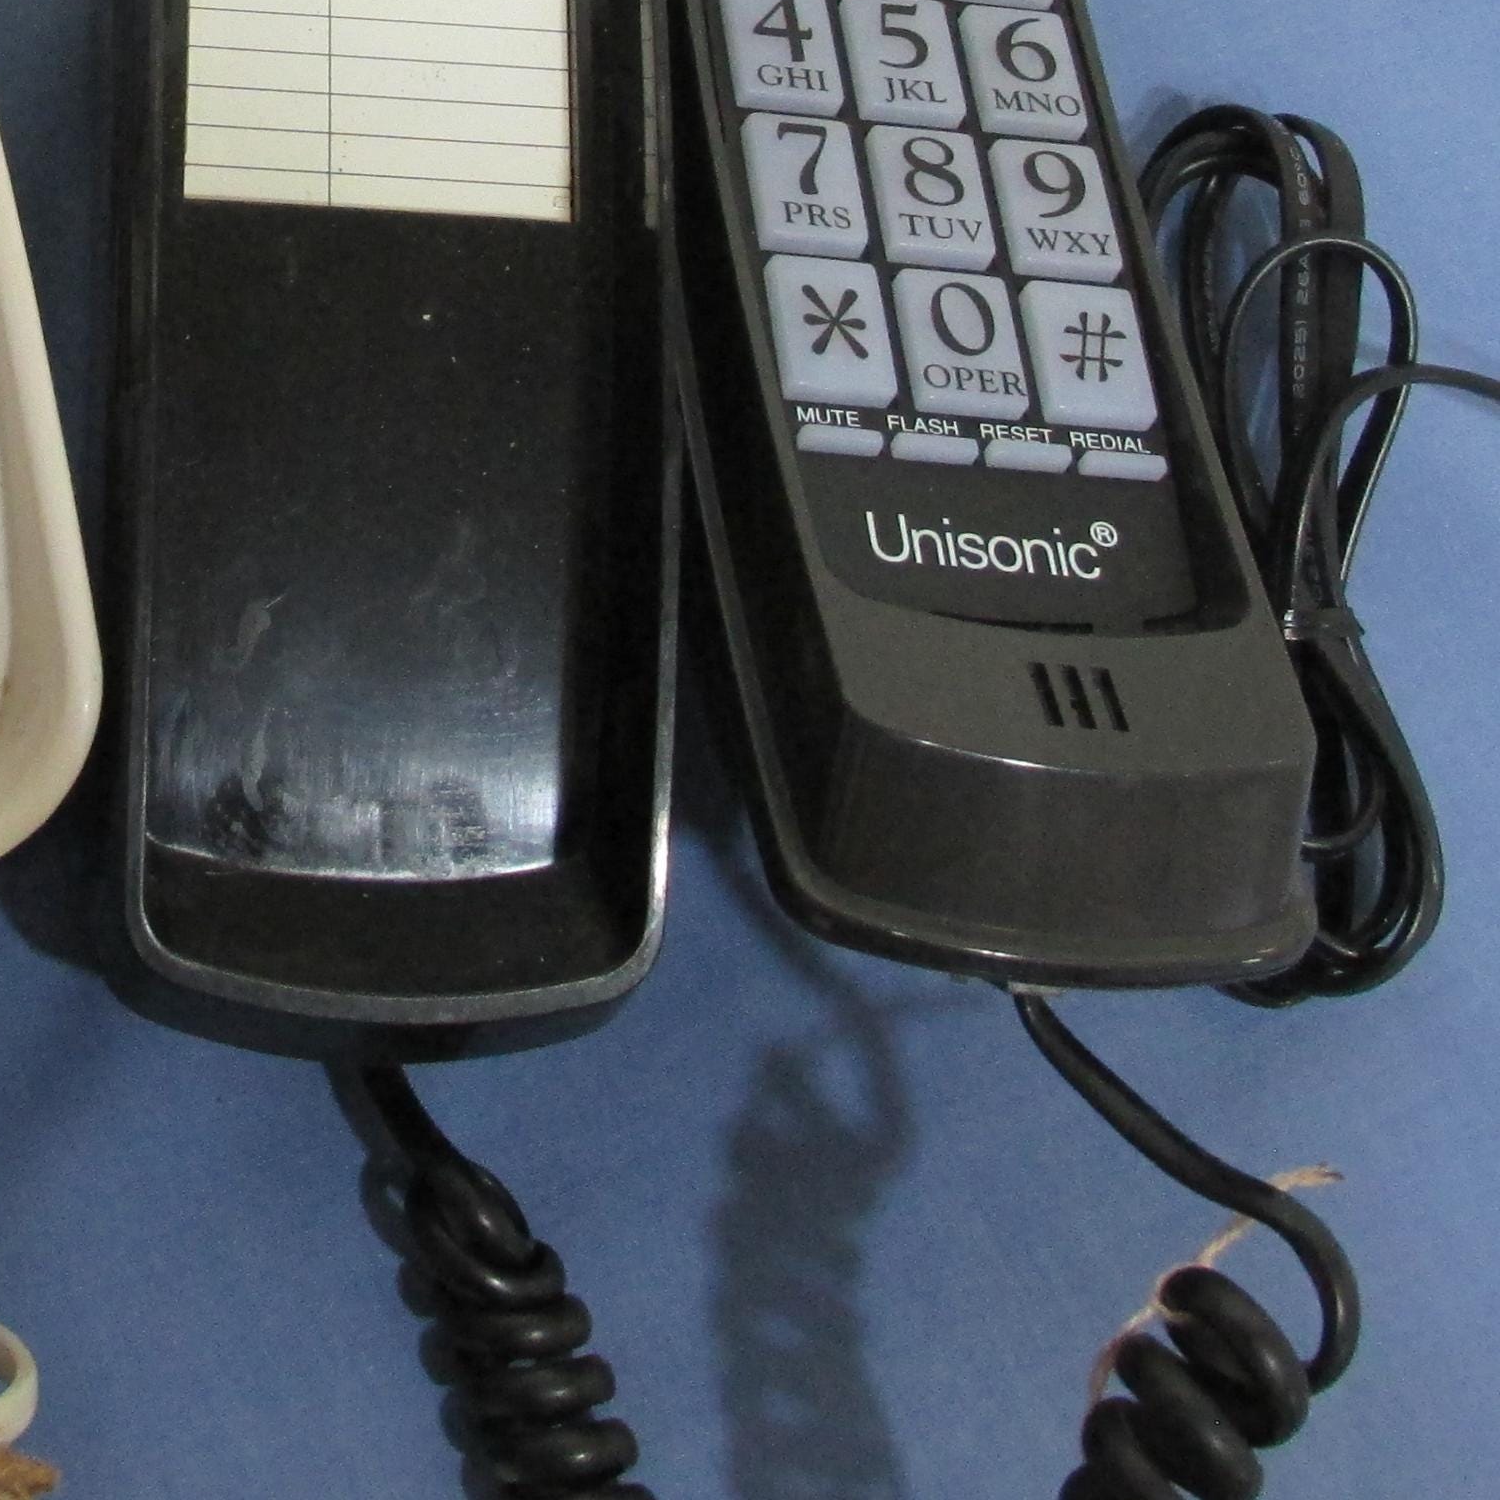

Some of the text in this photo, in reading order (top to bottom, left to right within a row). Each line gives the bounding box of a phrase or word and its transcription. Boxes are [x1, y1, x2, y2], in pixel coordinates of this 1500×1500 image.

[879, 3, 929, 70] 5
[995, 17, 1057, 83] 6
[756, 64, 829, 92] GHI
[884, 77, 947, 103] JKL
[993, 88, 1080, 117] MNO
[776, 122, 827, 196] 7
[902, 136, 965, 206] 8
[1023, 151, 1085, 218] 9
[781, 200, 852, 230] PRS
[900, 213, 983, 242] TUV
[1026, 226, 1114, 257] WXY
[930, 282, 996, 357] 0
[923, 364, 1027, 397] OPER
[796, 406, 1151, 453] MUTE FLASH RESET REDIAL
